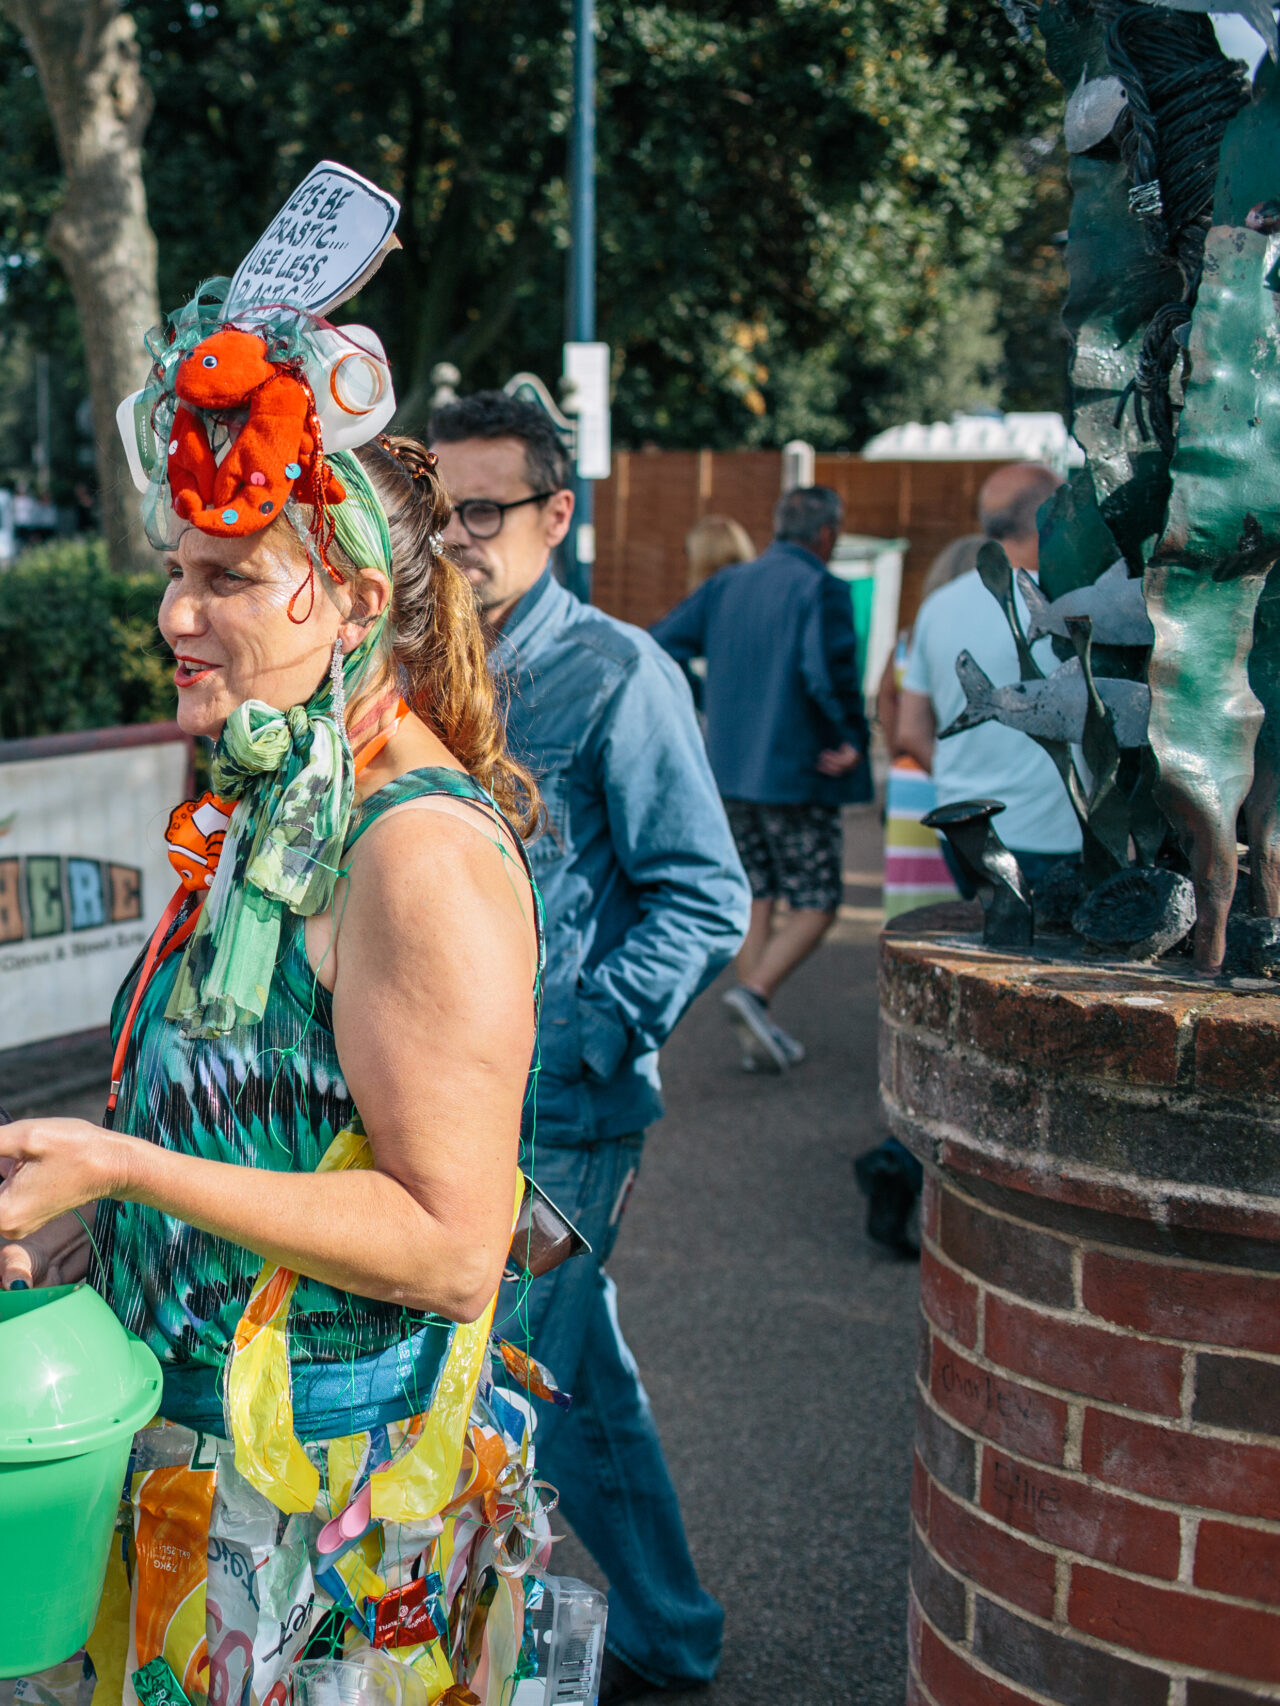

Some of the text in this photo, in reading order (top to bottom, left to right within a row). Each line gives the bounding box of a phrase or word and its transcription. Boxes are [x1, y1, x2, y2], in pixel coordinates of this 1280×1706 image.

[288, 177, 355, 220] LET'S BE
[248, 247, 328, 285] USE LESS
